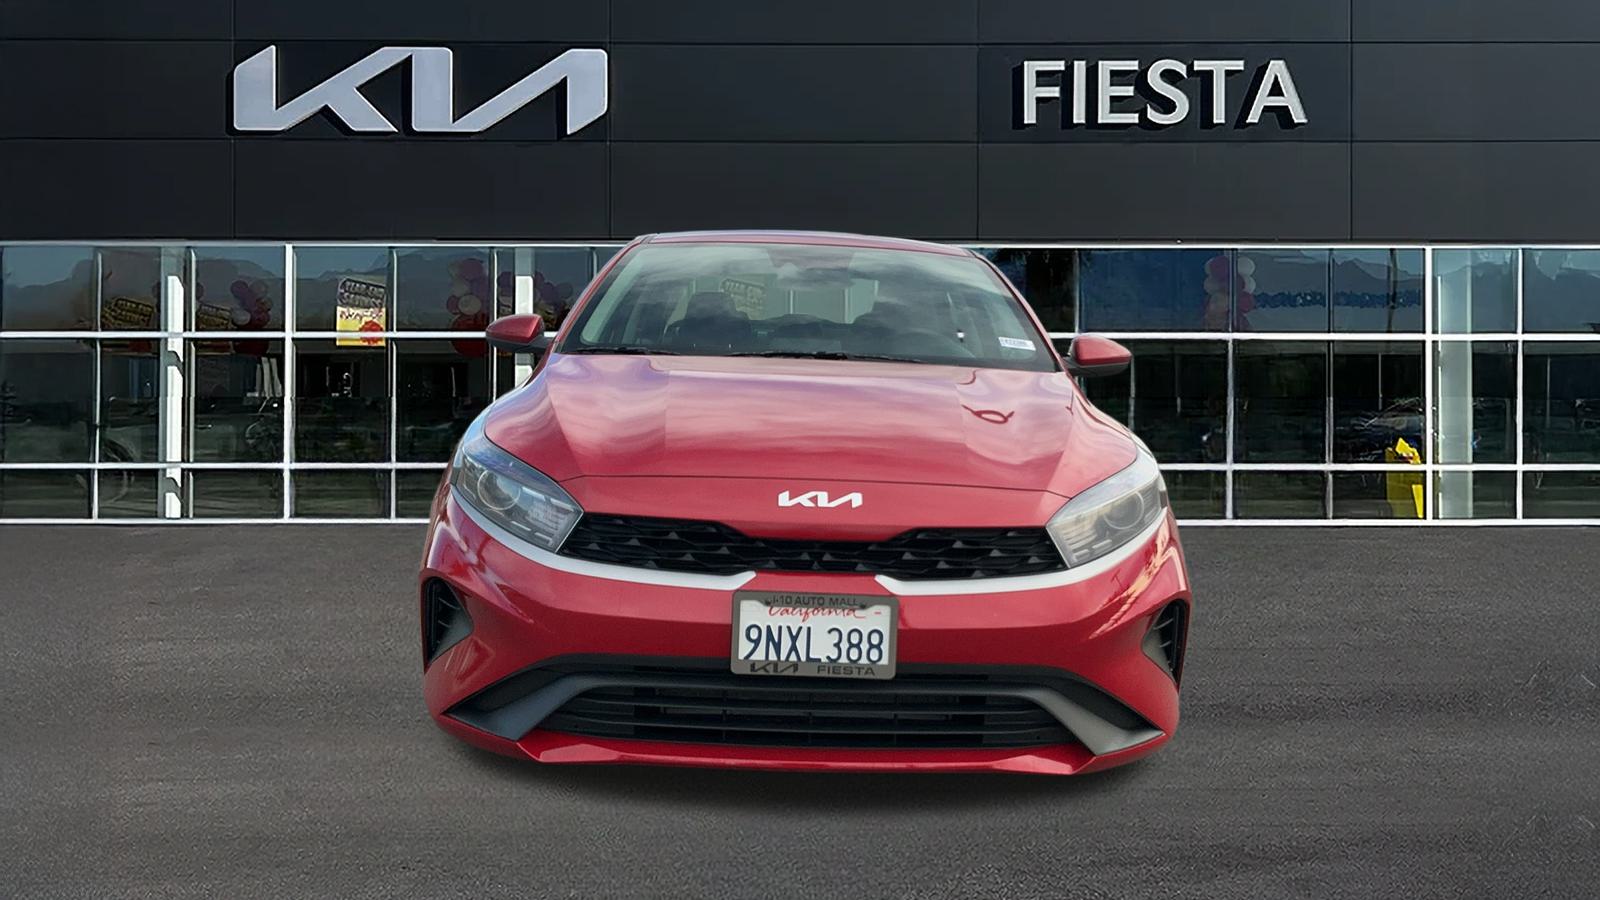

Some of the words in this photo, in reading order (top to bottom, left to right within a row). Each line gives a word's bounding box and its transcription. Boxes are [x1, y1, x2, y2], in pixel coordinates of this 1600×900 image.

[233, 44, 609, 135] KIA
[1023, 58, 1309, 125] FIESTA
[778, 490, 863, 508] KIA
[794, 596, 825, 606] AUTO
[829, 597, 858, 607] MALL
[743, 624, 884, 664] 9NXL388
[817, 665, 876, 676] FIESTA
